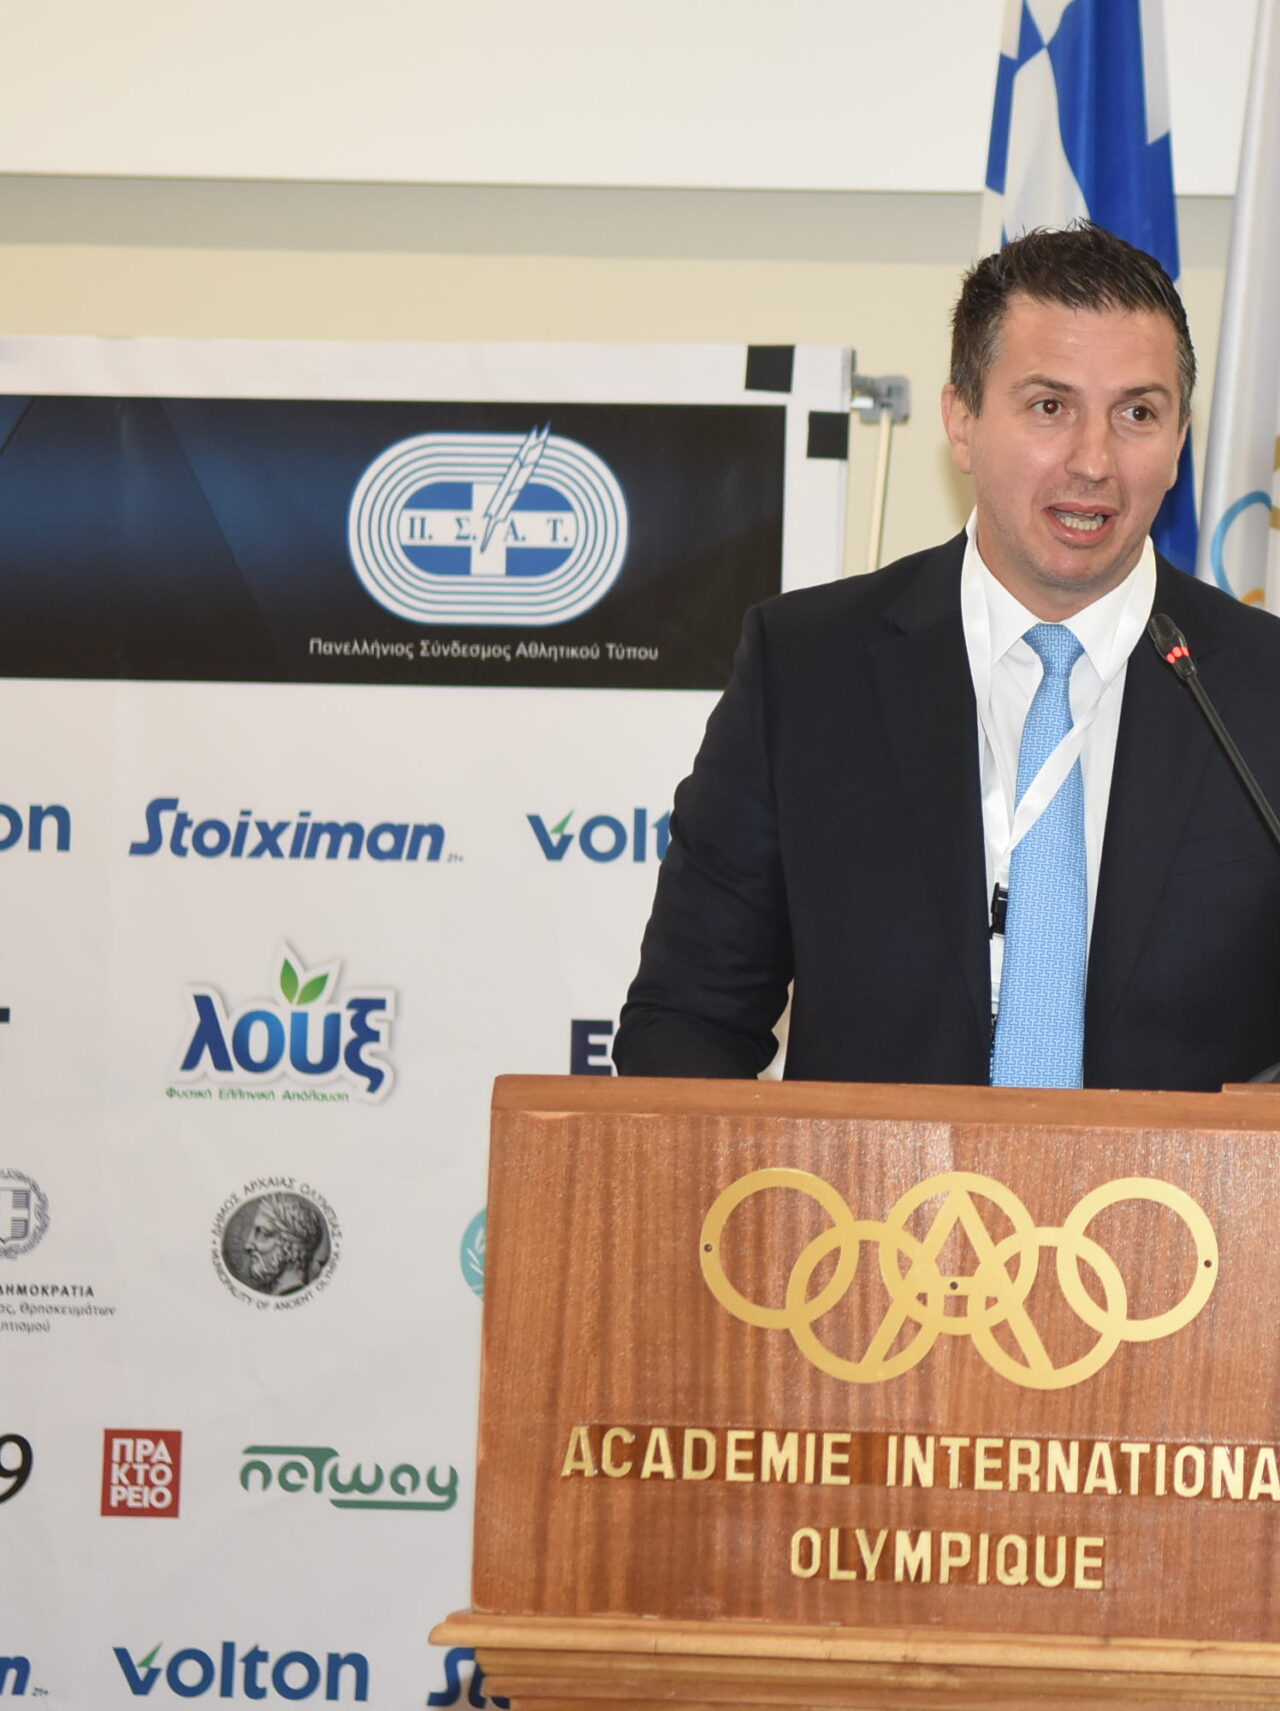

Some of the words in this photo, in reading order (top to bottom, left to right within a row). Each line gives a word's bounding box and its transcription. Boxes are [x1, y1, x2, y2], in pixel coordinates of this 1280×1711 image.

[309, 638, 414, 660] Πανελλήνιος
[419, 640, 511, 662] Σύνδεσμος
[515, 640, 600, 662] Αθλητικού
[605, 642, 659, 661] Τύπου
[129, 797, 446, 862] Stoiximan
[112, 1438, 173, 1464] ΠΡΑ
[560, 1425, 852, 1486] ACADEMIE
[111, 1462, 173, 1487] ΚΤΟ
[110, 1485, 173, 1509] ΡΕΙΟ
[790, 1527, 1104, 1590] OLYMPIQUE
